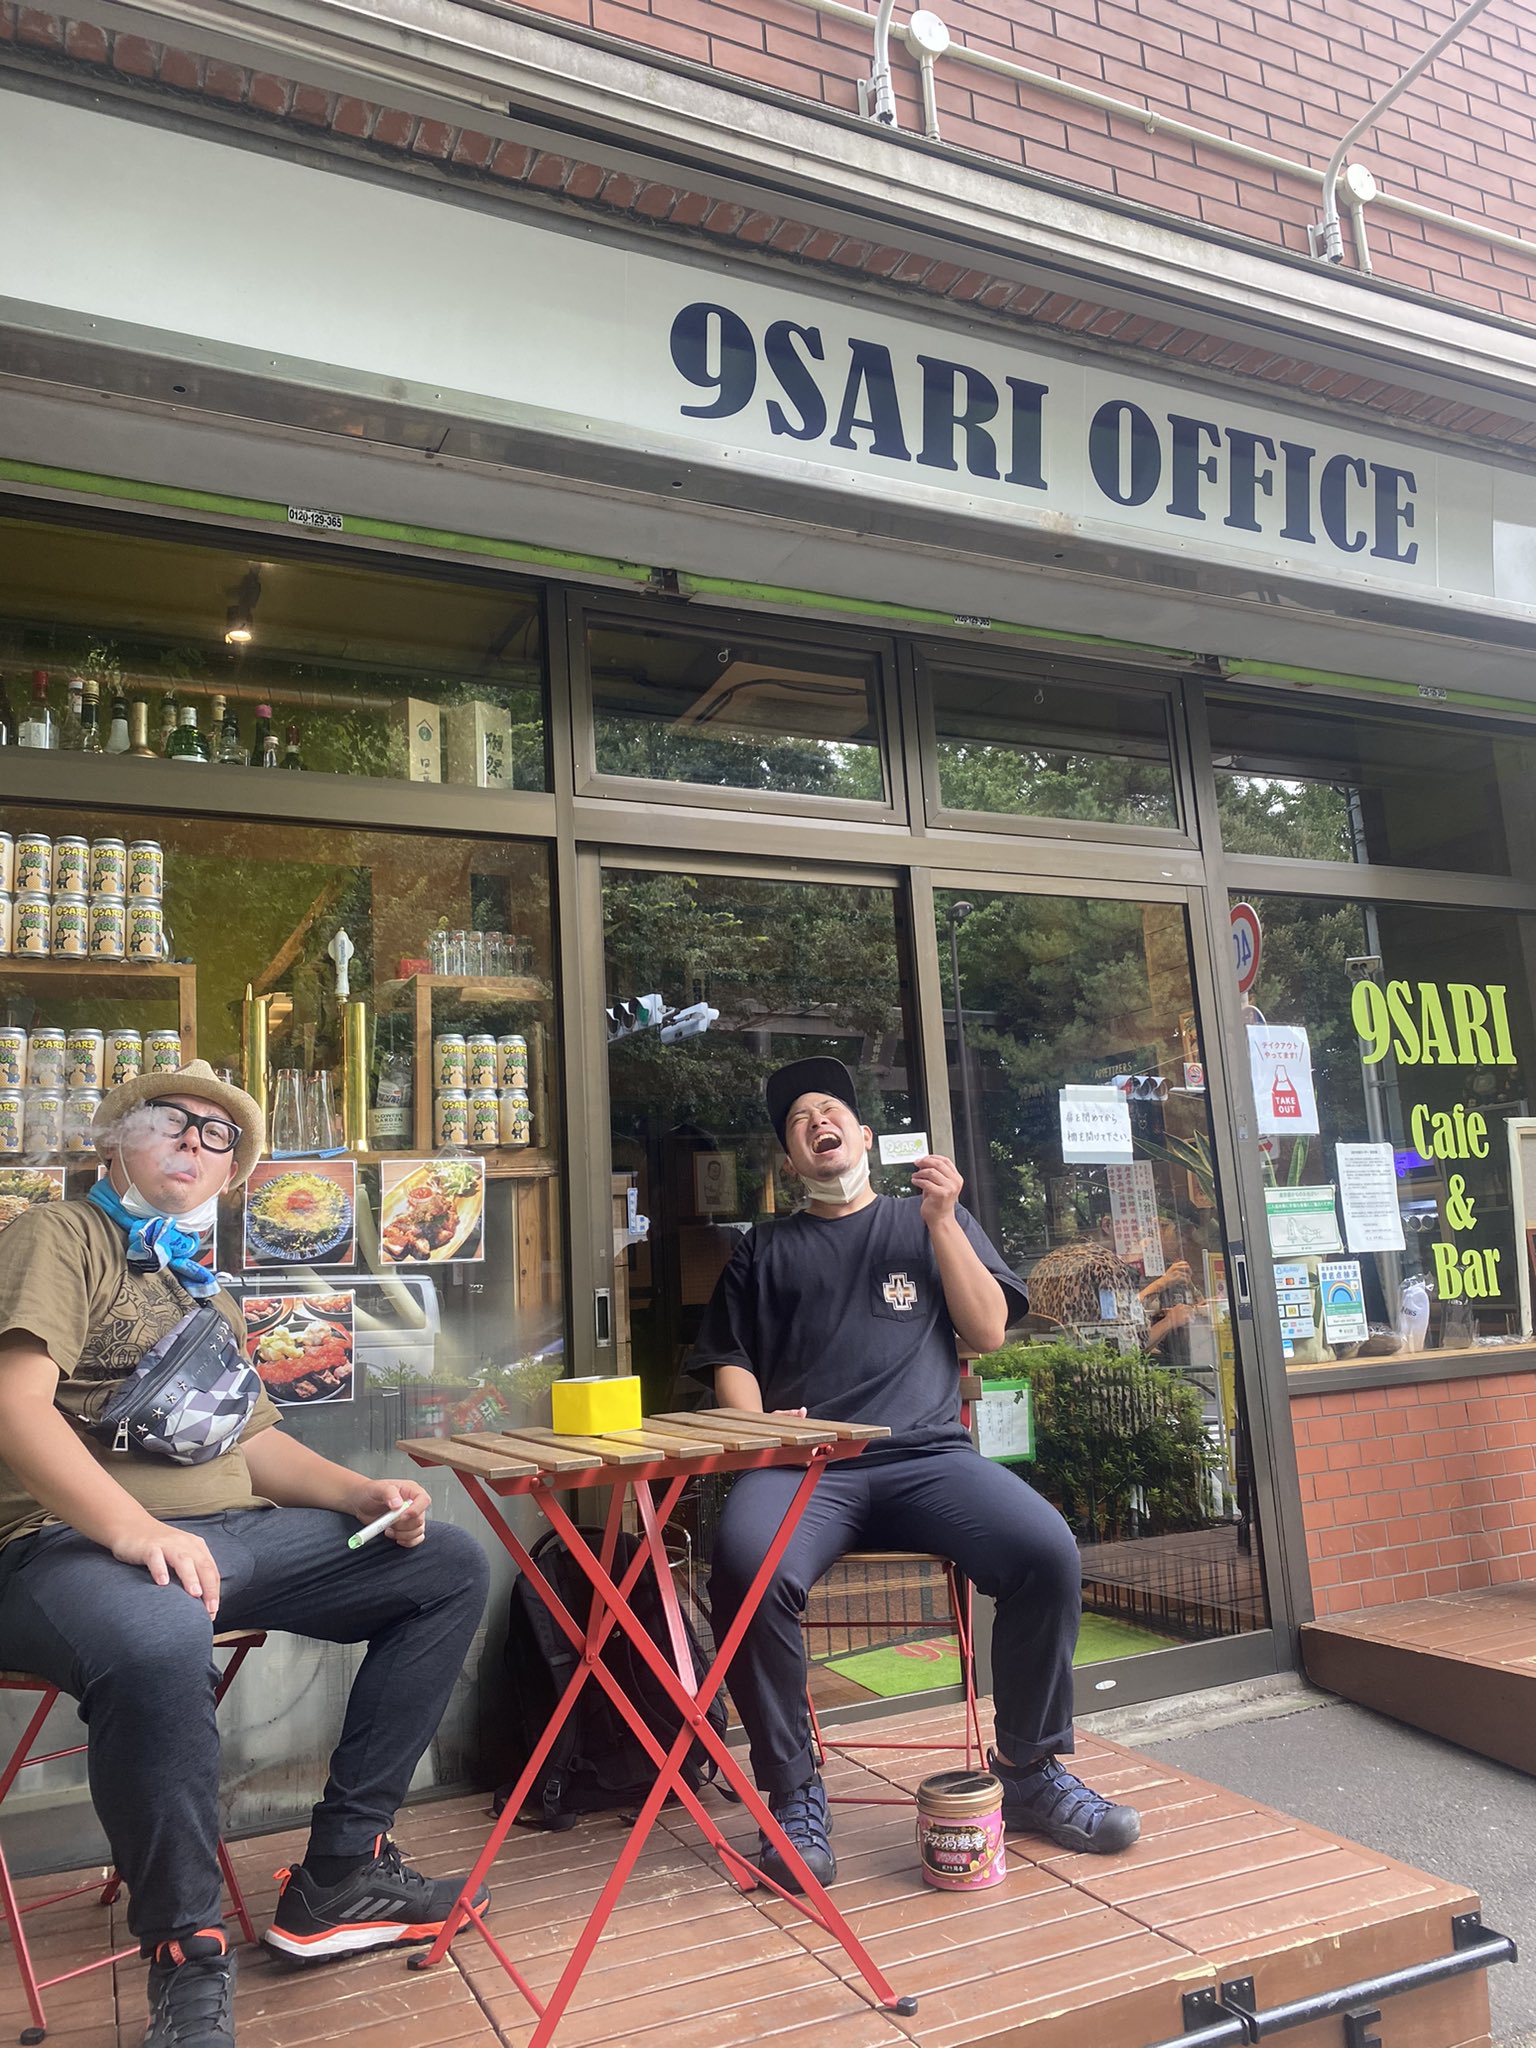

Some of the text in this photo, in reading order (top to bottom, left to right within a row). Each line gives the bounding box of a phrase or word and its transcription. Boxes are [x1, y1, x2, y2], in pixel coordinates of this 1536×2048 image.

[669, 301, 1417, 566] 9SARI OFFICE
[1262, 1041, 1298, 1050] テイクアウト
[1351, 980, 1517, 1064] 9SARI
[1275, 1097, 1296, 1105] TAKE
[1411, 1103, 1489, 1160] Cafe
[1446, 1173, 1477, 1231] &
[1431, 1242, 1501, 1300] Bar
